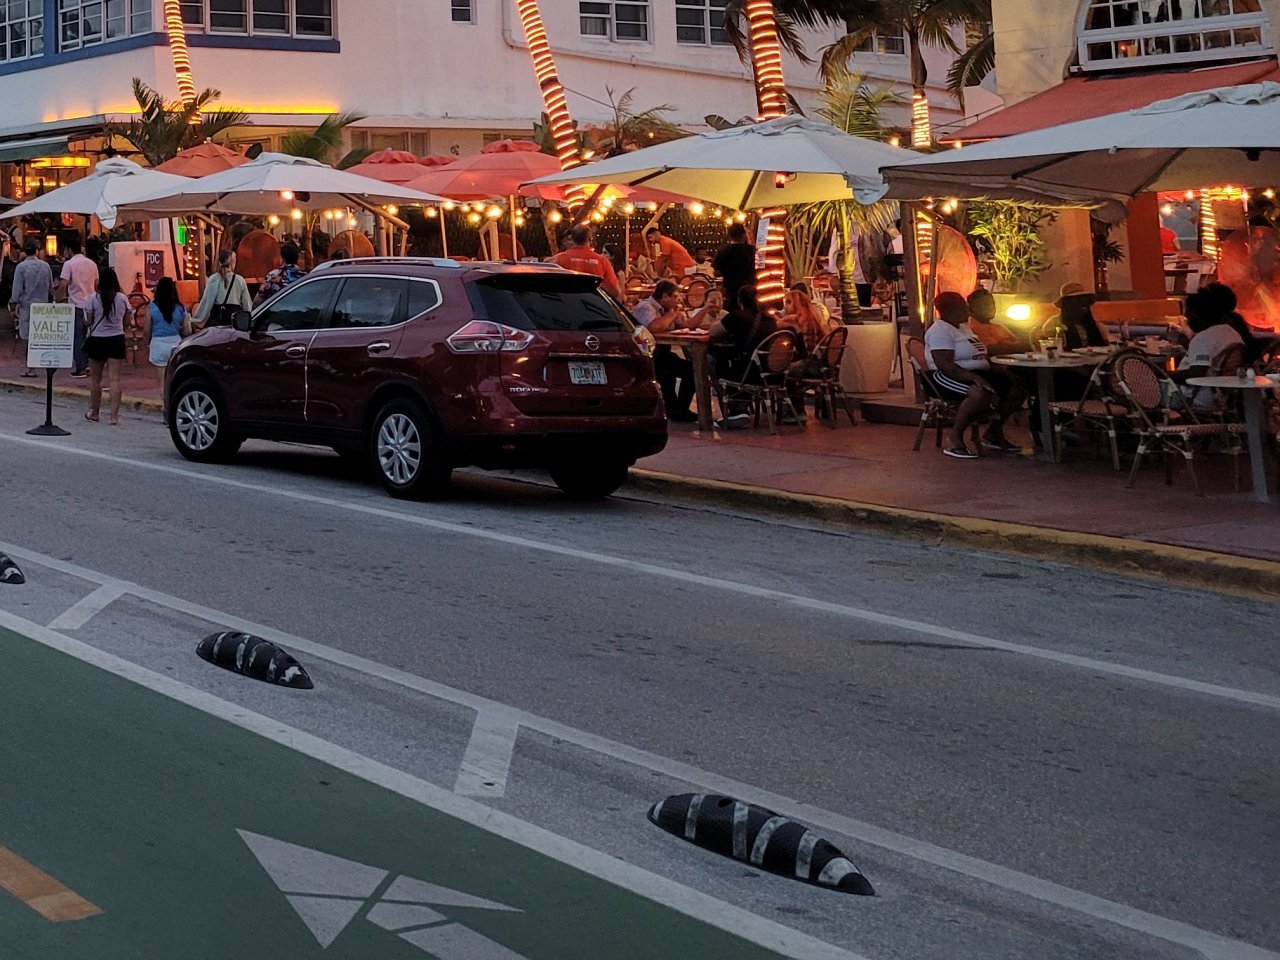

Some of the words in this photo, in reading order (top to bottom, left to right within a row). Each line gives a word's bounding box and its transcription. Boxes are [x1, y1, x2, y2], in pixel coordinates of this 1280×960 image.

[146, 253, 160, 265] FDC
[32, 320, 72, 333] VALET
[33, 333, 70, 342] PARKING
